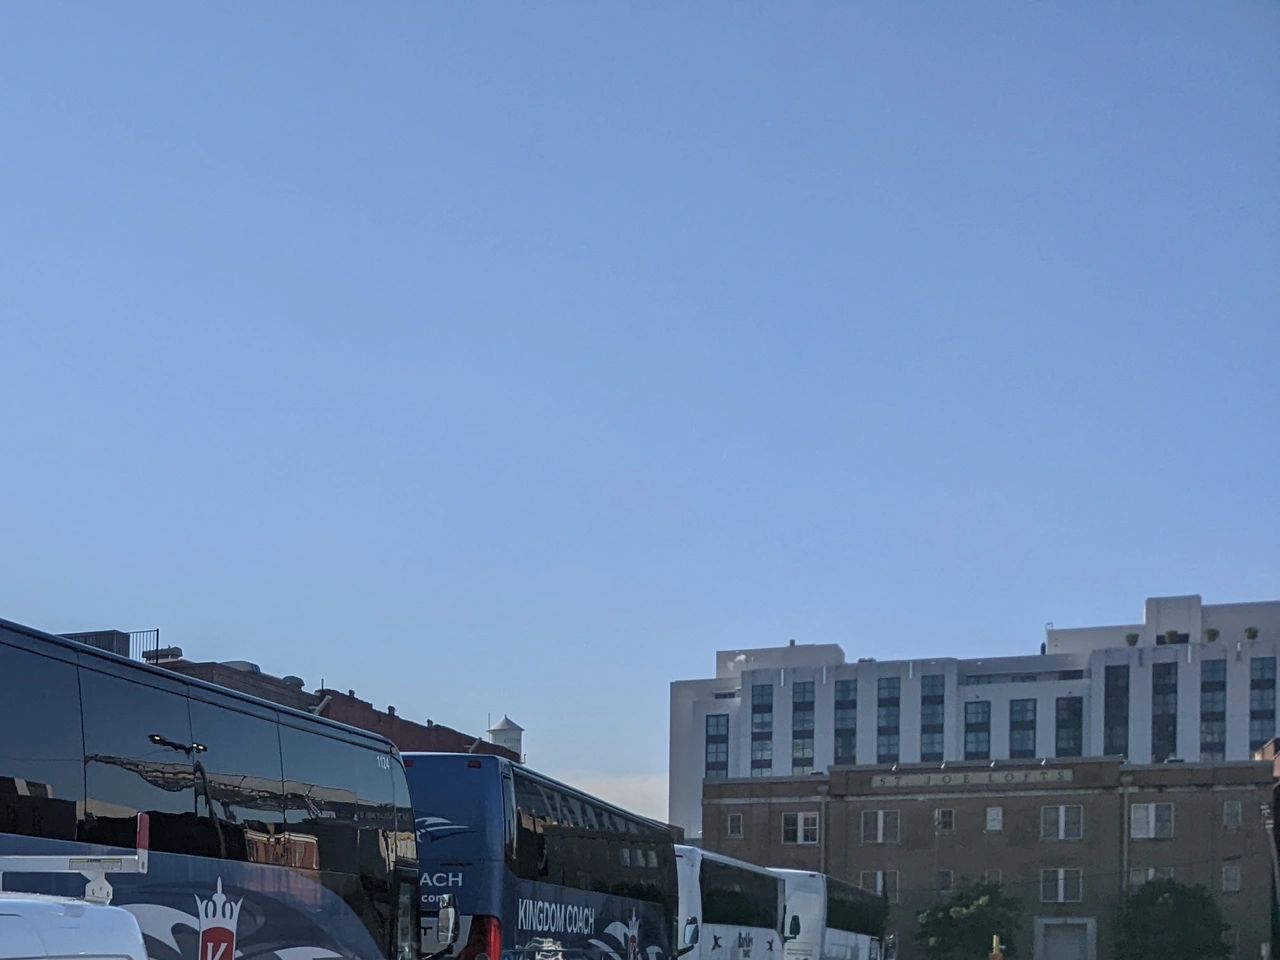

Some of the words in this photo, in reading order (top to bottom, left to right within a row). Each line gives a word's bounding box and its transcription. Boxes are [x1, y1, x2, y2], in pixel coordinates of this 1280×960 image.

[376, 755, 390, 770] 1124
[926, 774, 970, 785] JOE
[987, 771, 1065, 783] LOFTS
[518, 898, 565, 933] KINGDOM
[566, 904, 595, 935] COACH
